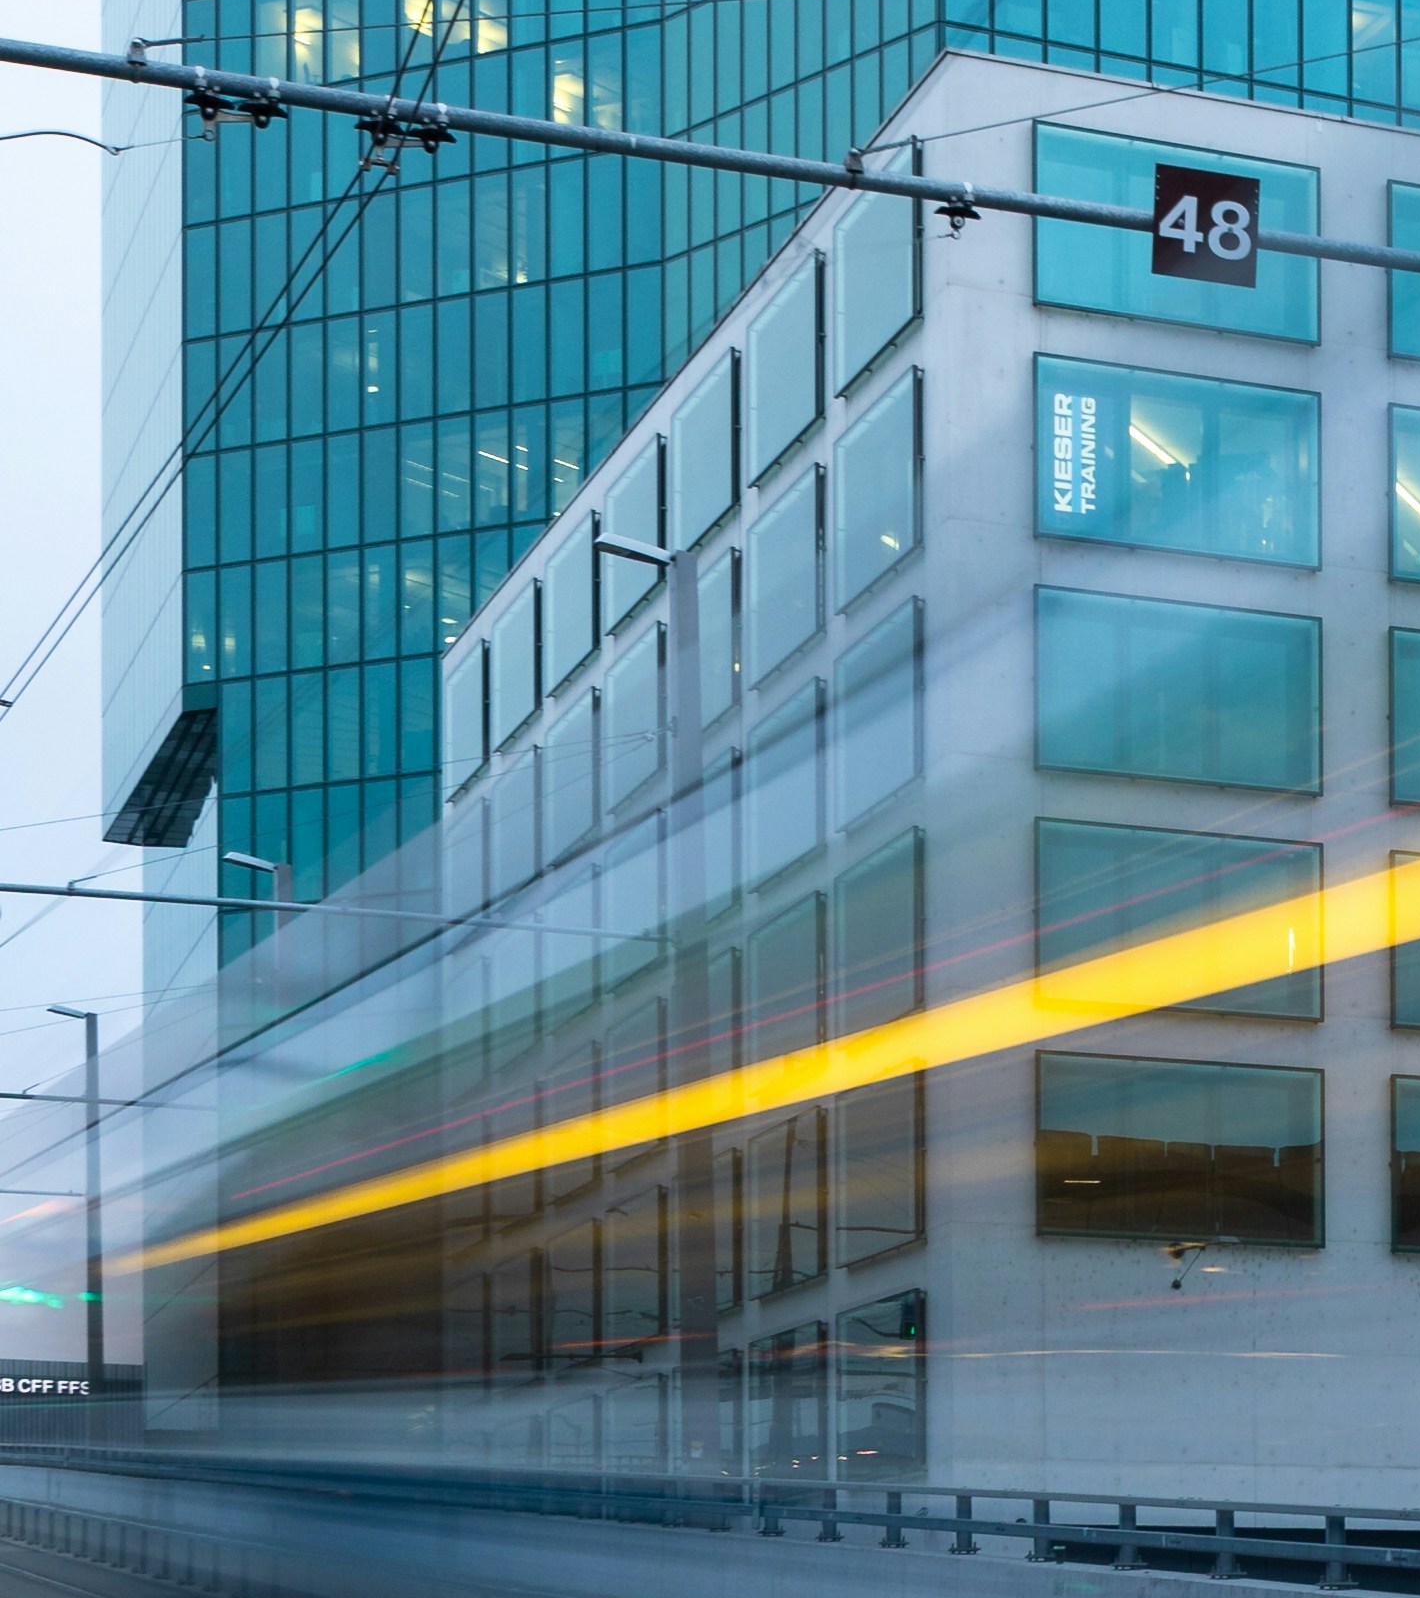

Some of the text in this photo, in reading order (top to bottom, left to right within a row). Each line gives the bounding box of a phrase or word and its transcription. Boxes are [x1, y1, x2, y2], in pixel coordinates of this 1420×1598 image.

[1158, 194, 1252, 261] 48
[1053, 393, 1073, 513] KIESER
[1080, 396, 1097, 515] TRAINING
[17, 1378, 54, 1394] CFF
